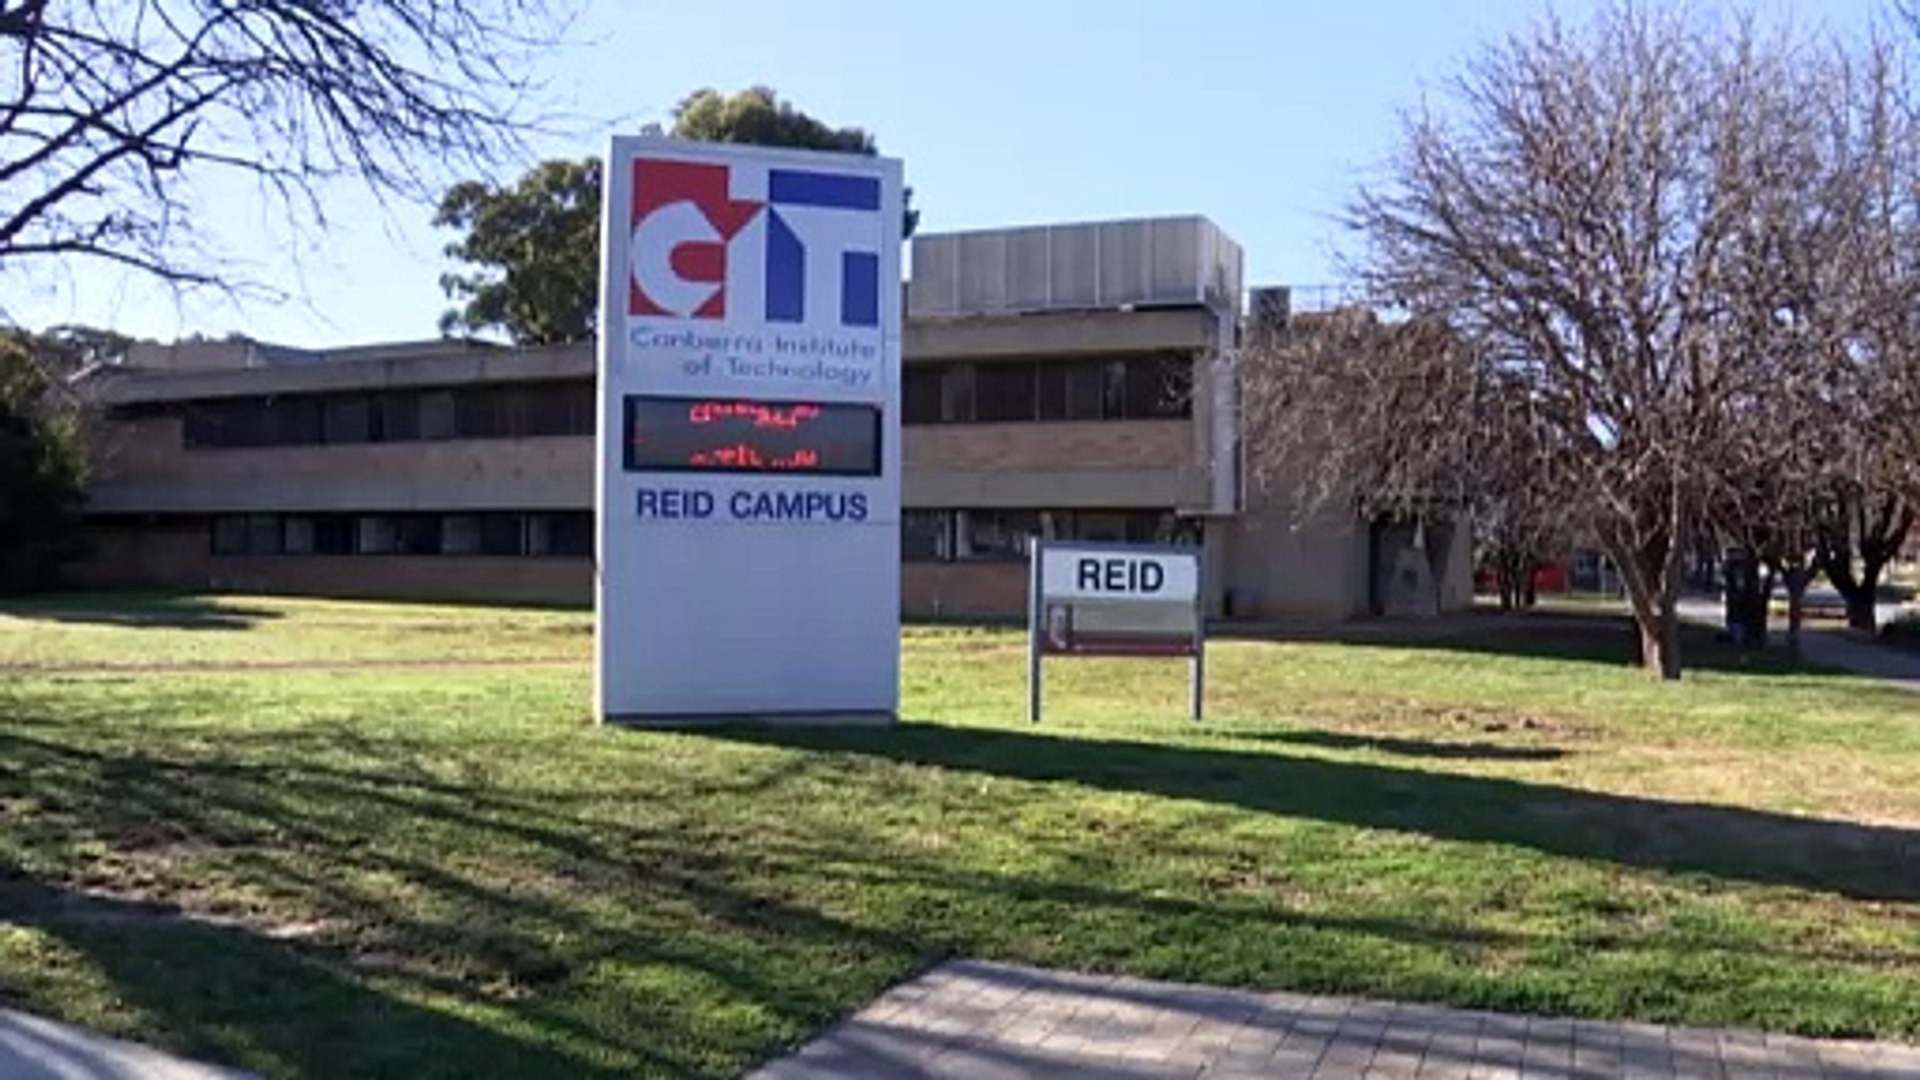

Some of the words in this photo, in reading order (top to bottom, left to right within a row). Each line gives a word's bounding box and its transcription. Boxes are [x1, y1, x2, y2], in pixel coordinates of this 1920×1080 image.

[630, 326, 763, 353] Canberra
[776, 335, 876, 356] Institute
[682, 354, 712, 376] of
[727, 356, 872, 385] Technology
[636, 489, 715, 519] REID
[730, 490, 869, 521] CAMPUS
[1077, 558, 1165, 593] REID
